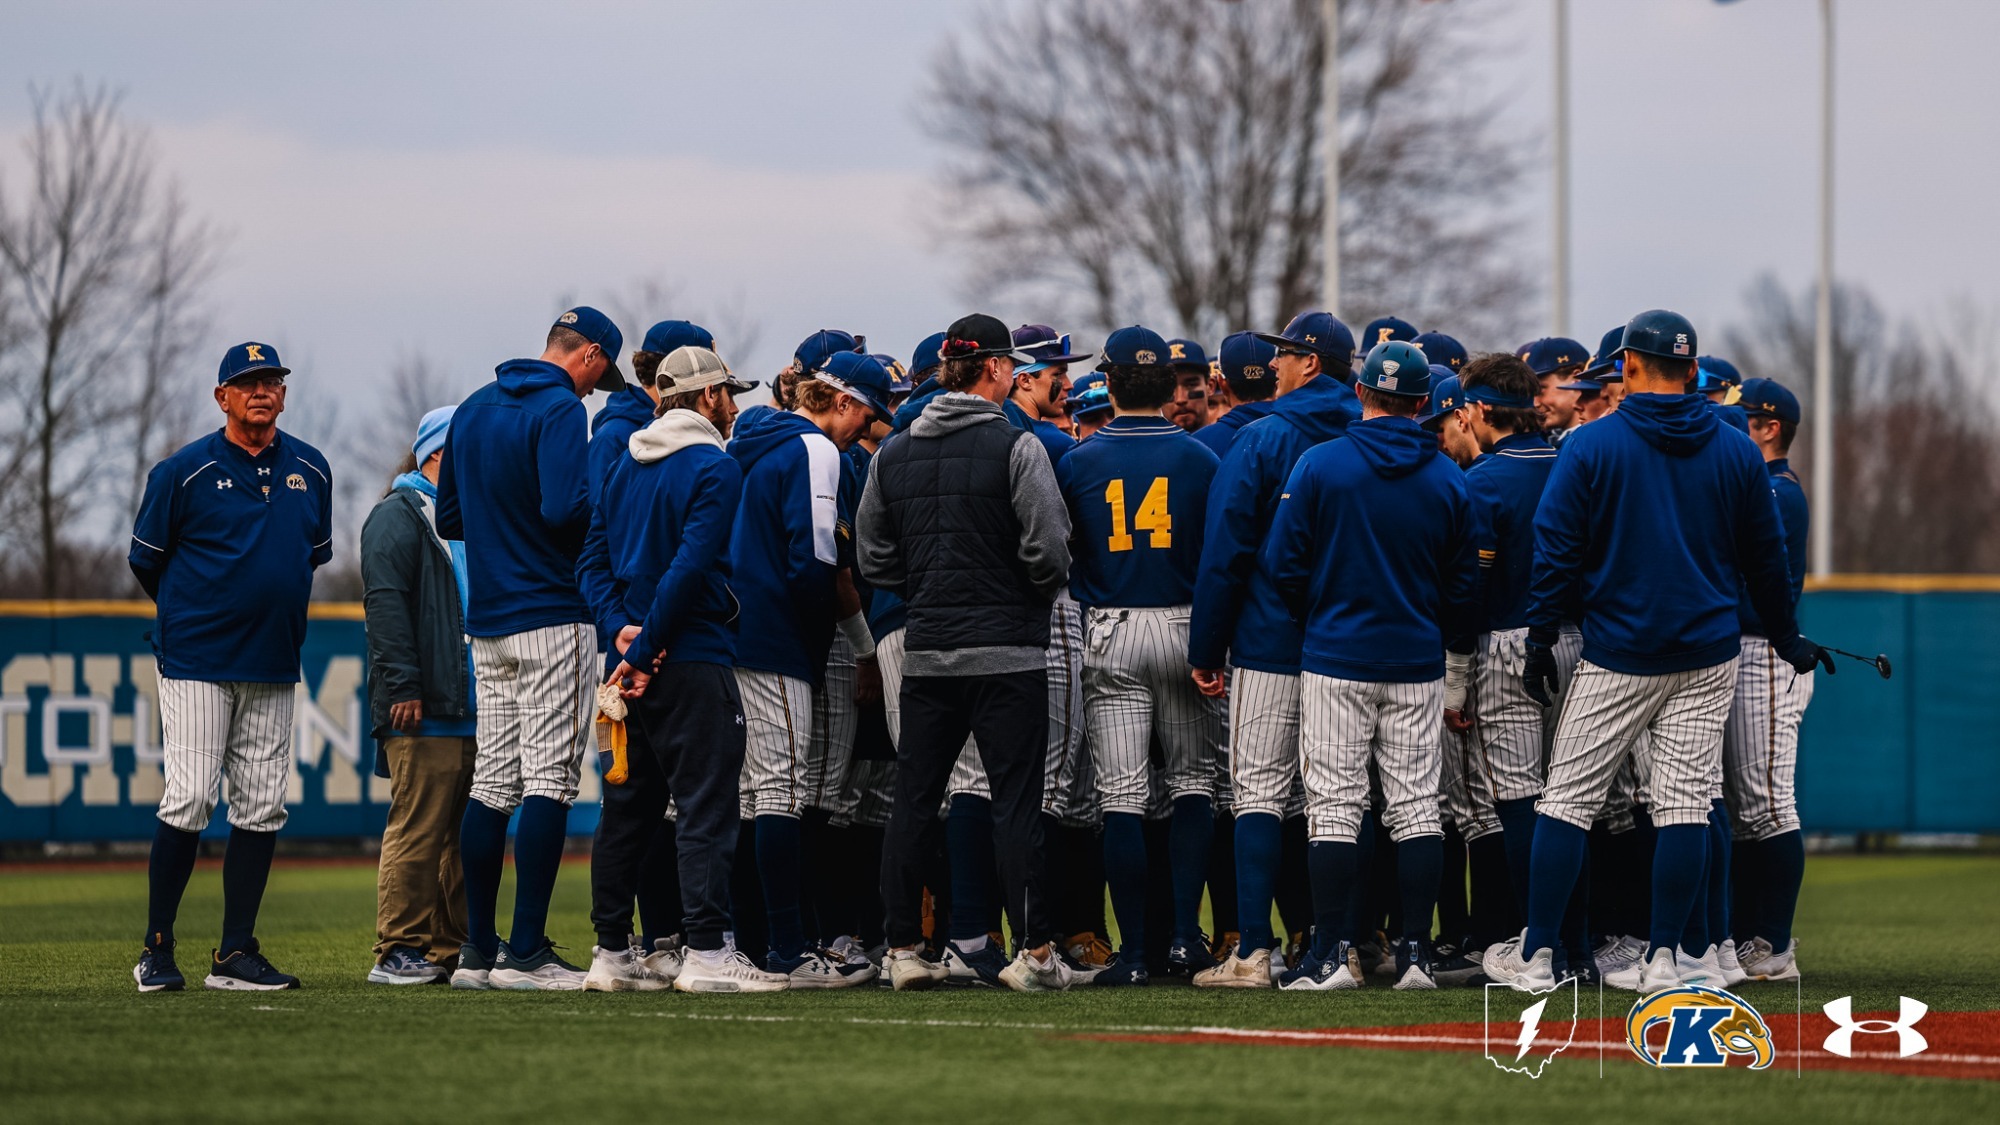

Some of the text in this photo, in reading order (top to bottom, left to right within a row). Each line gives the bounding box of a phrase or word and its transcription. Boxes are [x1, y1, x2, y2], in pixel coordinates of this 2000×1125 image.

[1376, 328, 1395, 344] K
[1675, 333, 1688, 344] 25
[246, 345, 265, 361] K
[1169, 344, 1186, 359] K
[1105, 477, 1171, 552] 14
